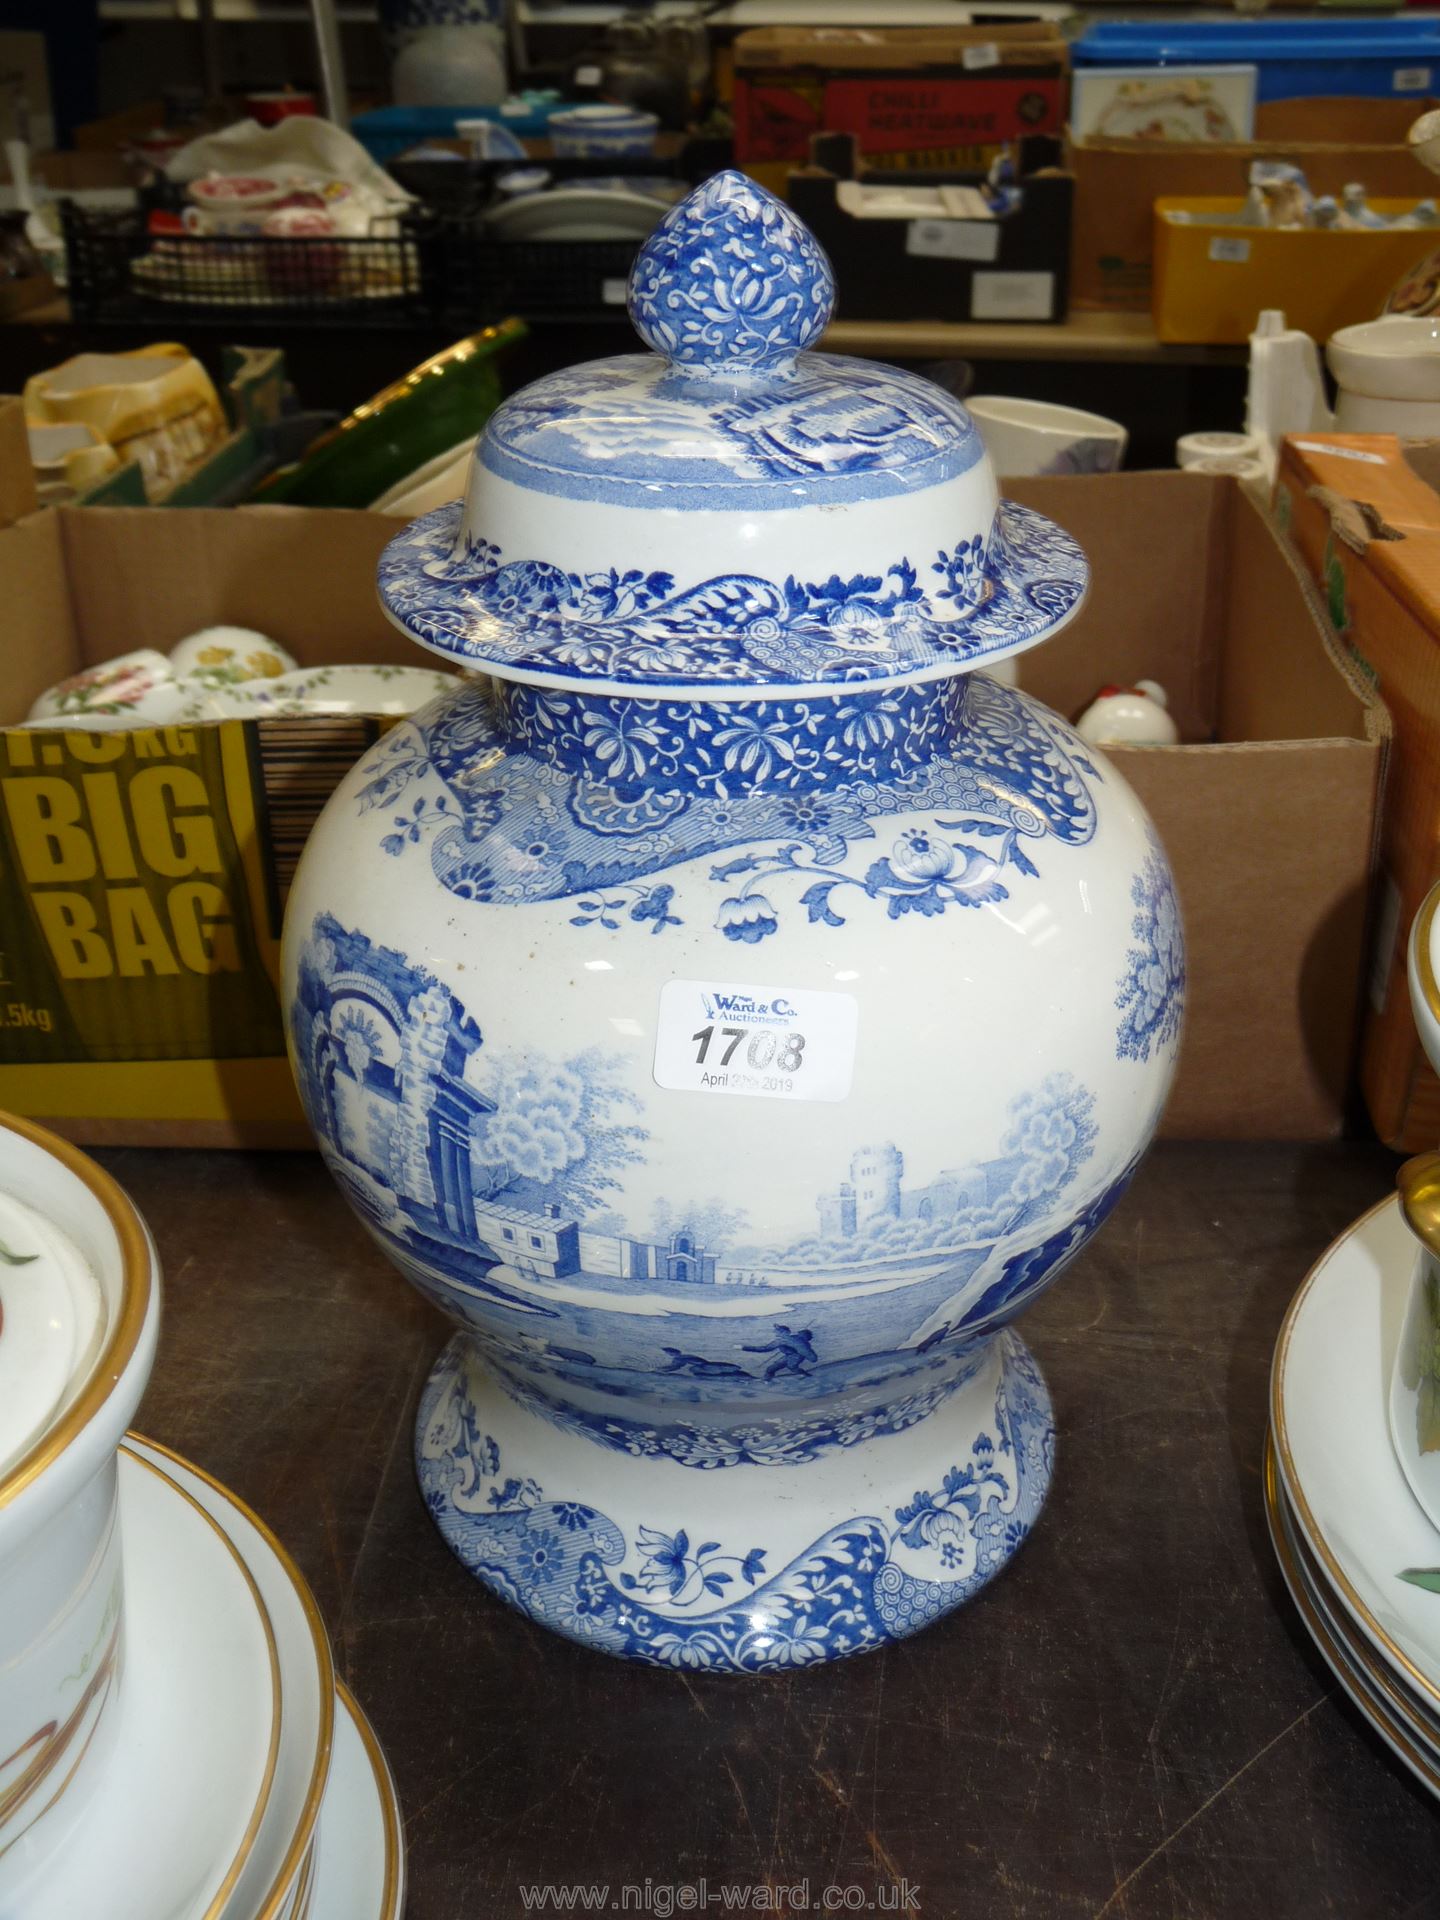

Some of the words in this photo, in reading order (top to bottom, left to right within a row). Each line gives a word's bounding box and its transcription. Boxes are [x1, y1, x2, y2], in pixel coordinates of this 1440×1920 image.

[868, 91, 941, 111] CHILLI
[868, 111, 998, 132] HEATWAVE
[2, 765, 224, 882] BIG
[31, 881, 242, 979] BAG
[712, 993, 755, 1013] Ward
[757, 1004, 768, 1014] &
[771, 998, 798, 1016] Co.
[719, 1011, 789, 1026] Auctioneers
[691, 1025, 806, 1073] 1708
[701, 1072, 729, 1088] April
[761, 1076, 793, 1092] 2019
